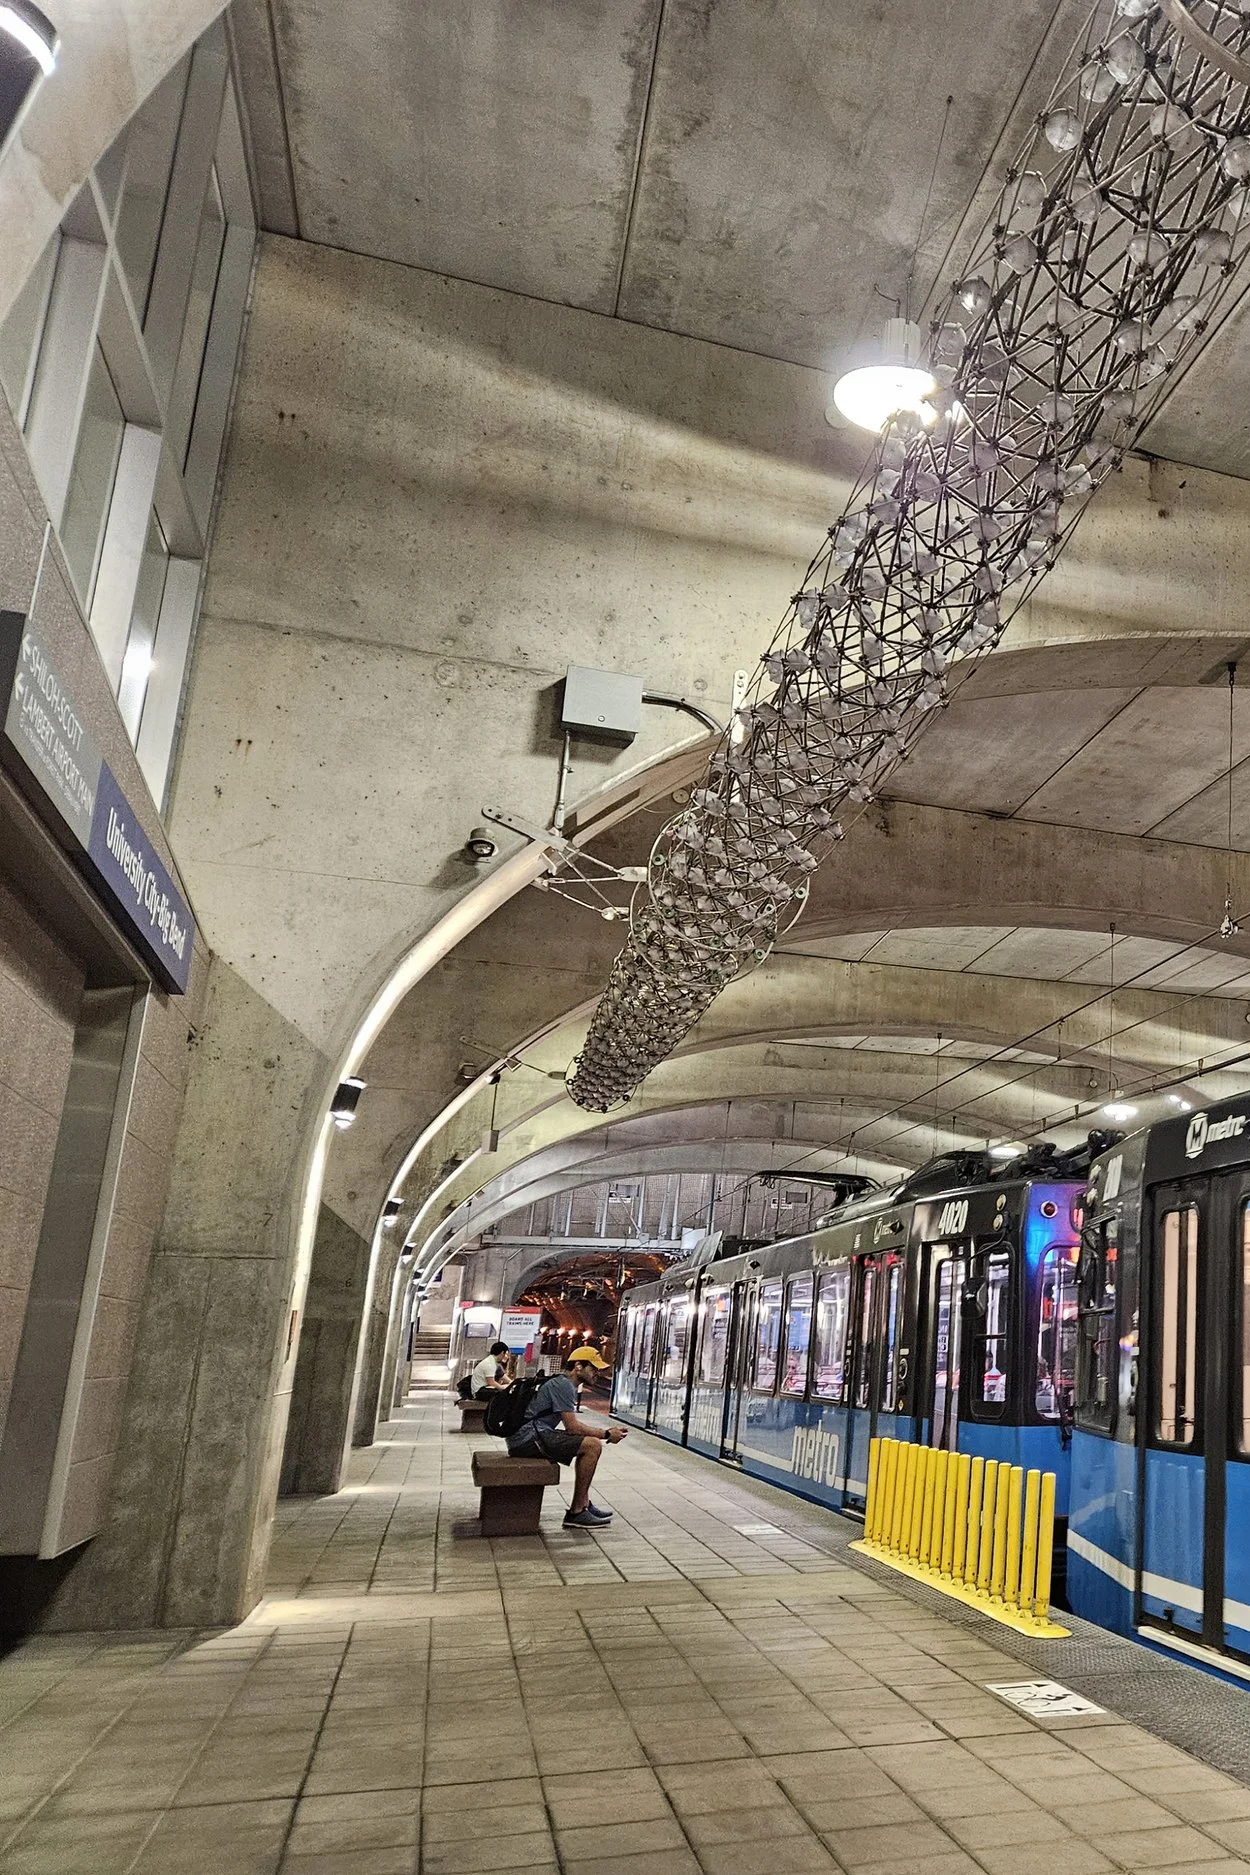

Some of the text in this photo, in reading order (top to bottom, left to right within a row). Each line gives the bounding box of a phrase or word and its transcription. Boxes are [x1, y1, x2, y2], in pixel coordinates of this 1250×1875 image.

[22, 685, 55, 751] LAMBERT
[51, 736, 80, 791] AIRPORT
[29, 645, 84, 751] SHILOH-SCOTT
[106, 806, 187, 960] University City-Big Bend
[938, 1199, 969, 1236] 4020
[791, 1419, 840, 1488] metro
